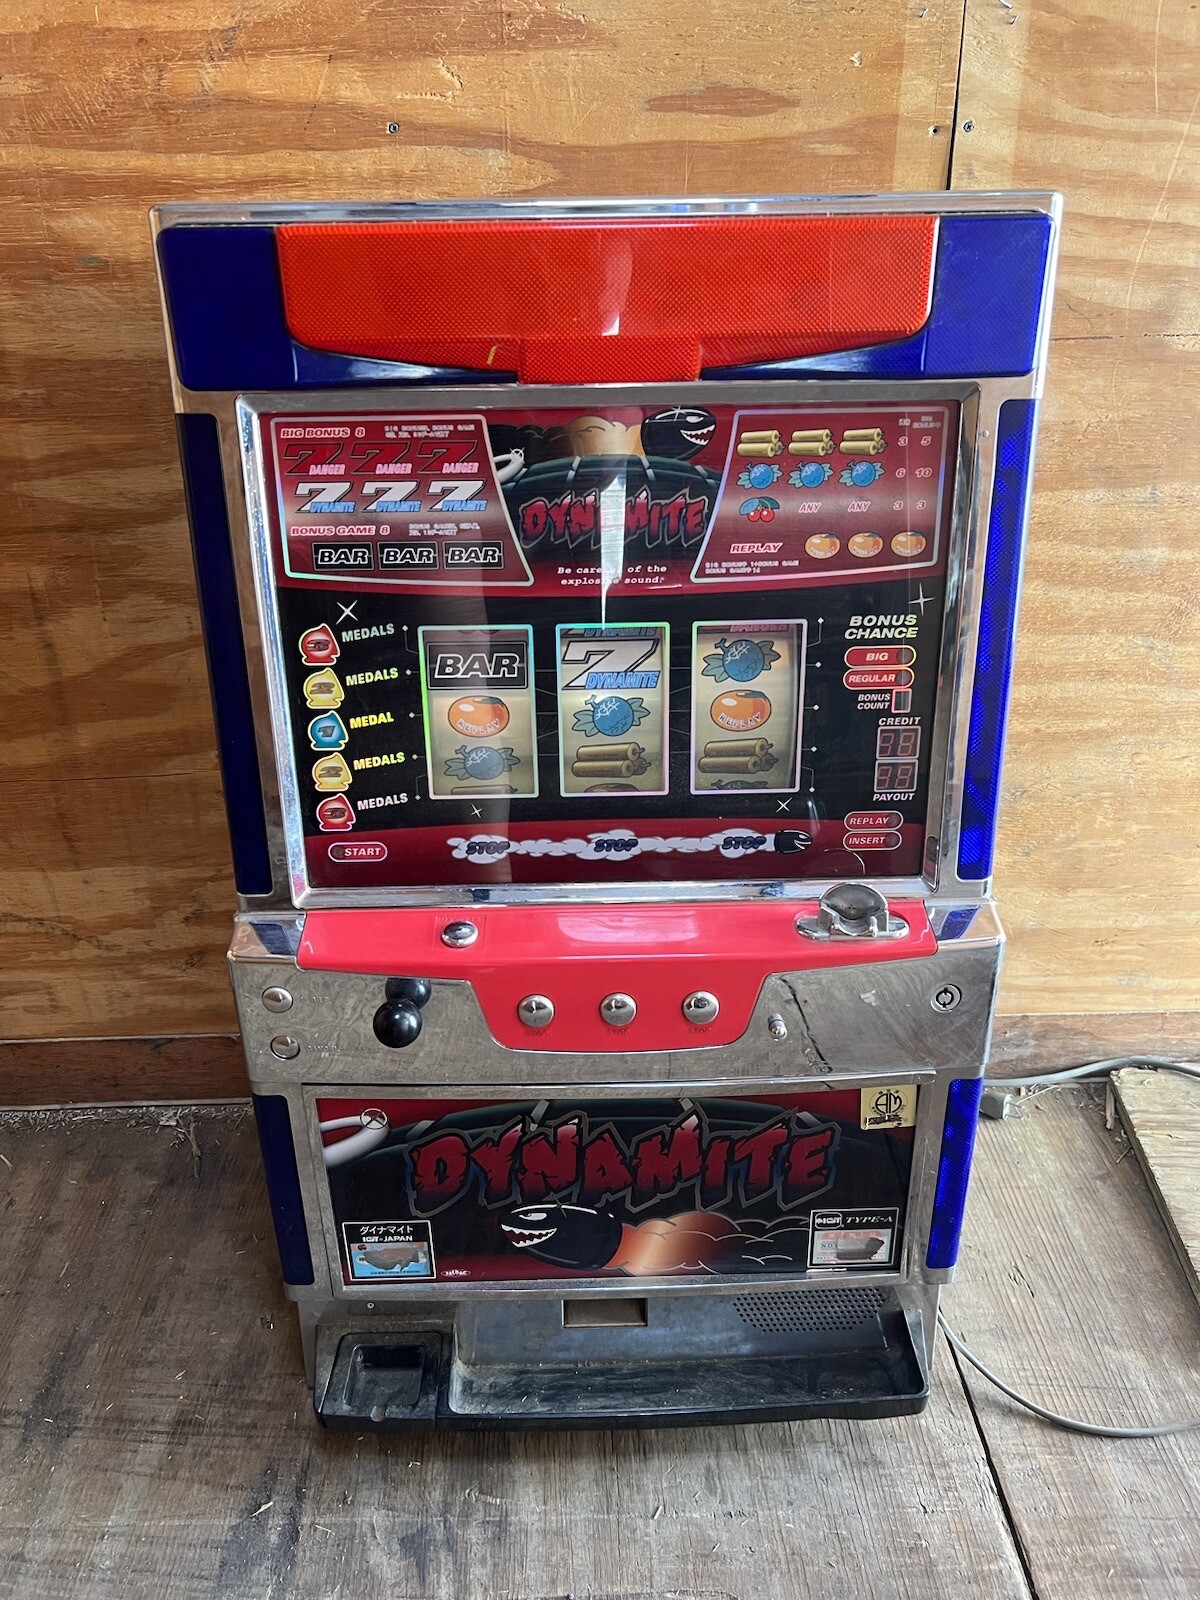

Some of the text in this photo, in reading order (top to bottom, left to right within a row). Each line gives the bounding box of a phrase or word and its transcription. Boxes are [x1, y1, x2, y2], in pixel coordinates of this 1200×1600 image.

[281, 427, 366, 439] BIG BONUS 8
[898, 436, 932, 447] 3 5
[309, 462, 480, 476] DANGER DANGER DANGER
[895, 467, 933, 478] 6 10
[309, 500, 488, 513] DYNAMITE DYNAMITE DYNAMITE
[799, 500, 927, 513] ANY ANY 3 3
[521, 490, 706, 546] DYNMITE
[290, 525, 390, 536] BONUS GAME 8
[730, 543, 783, 553] REPLAY
[317, 546, 500, 565] BAR BAR BAR
[627, 565, 642, 573] of
[849, 614, 918, 627] BONUS
[341, 624, 395, 642] MEDALS
[844, 627, 919, 639] CHANCE
[865, 652, 889, 661] BIG
[434, 653, 521, 679] BAR
[561, 639, 659, 690] 7
[346, 668, 399, 686] MEDALS
[585, 671, 660, 689] DYNAMITE
[848, 674, 896, 683] REGULAR
[858, 693, 891, 701] BONUS
[857, 702, 890, 710] COUNT
[350, 712, 394, 729] MEDAL
[457, 718, 500, 734] REPLAY
[719, 712, 761, 728] REPLAY
[878, 717, 921, 725] CREDIT
[353, 752, 405, 771] MEDALS
[357, 793, 408, 810] MEDALS
[873, 793, 915, 801] PAYOUT
[849, 817, 889, 825] REPLAY
[466, 836, 767, 855] STOP STOP STOP
[848, 837, 886, 845] INSERT
[345, 847, 381, 856] START
[409, 1114, 838, 1201] DYNAMITE
[846, 1216, 893, 1224] TYPE-A
[359, 1225, 413, 1235] ダイナマイト
